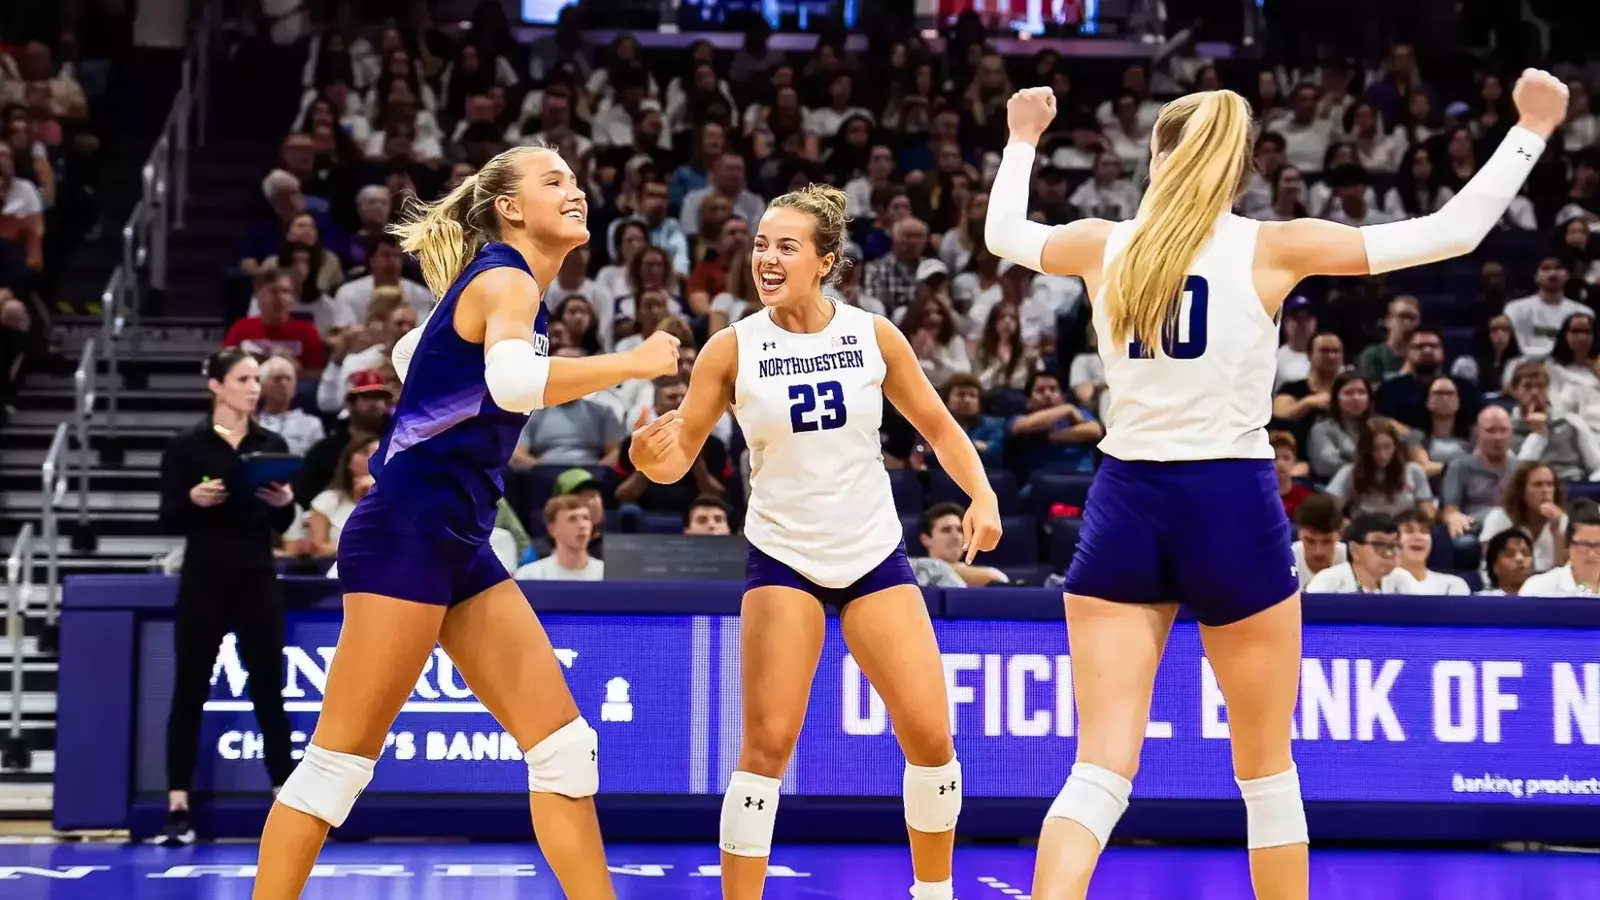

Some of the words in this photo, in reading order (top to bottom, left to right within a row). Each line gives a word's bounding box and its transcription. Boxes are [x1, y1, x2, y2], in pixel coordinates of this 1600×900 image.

[759, 350, 864, 378] NORTHWESTERN
[788, 381, 847, 433] 23
[1432, 660, 1523, 743] OF
